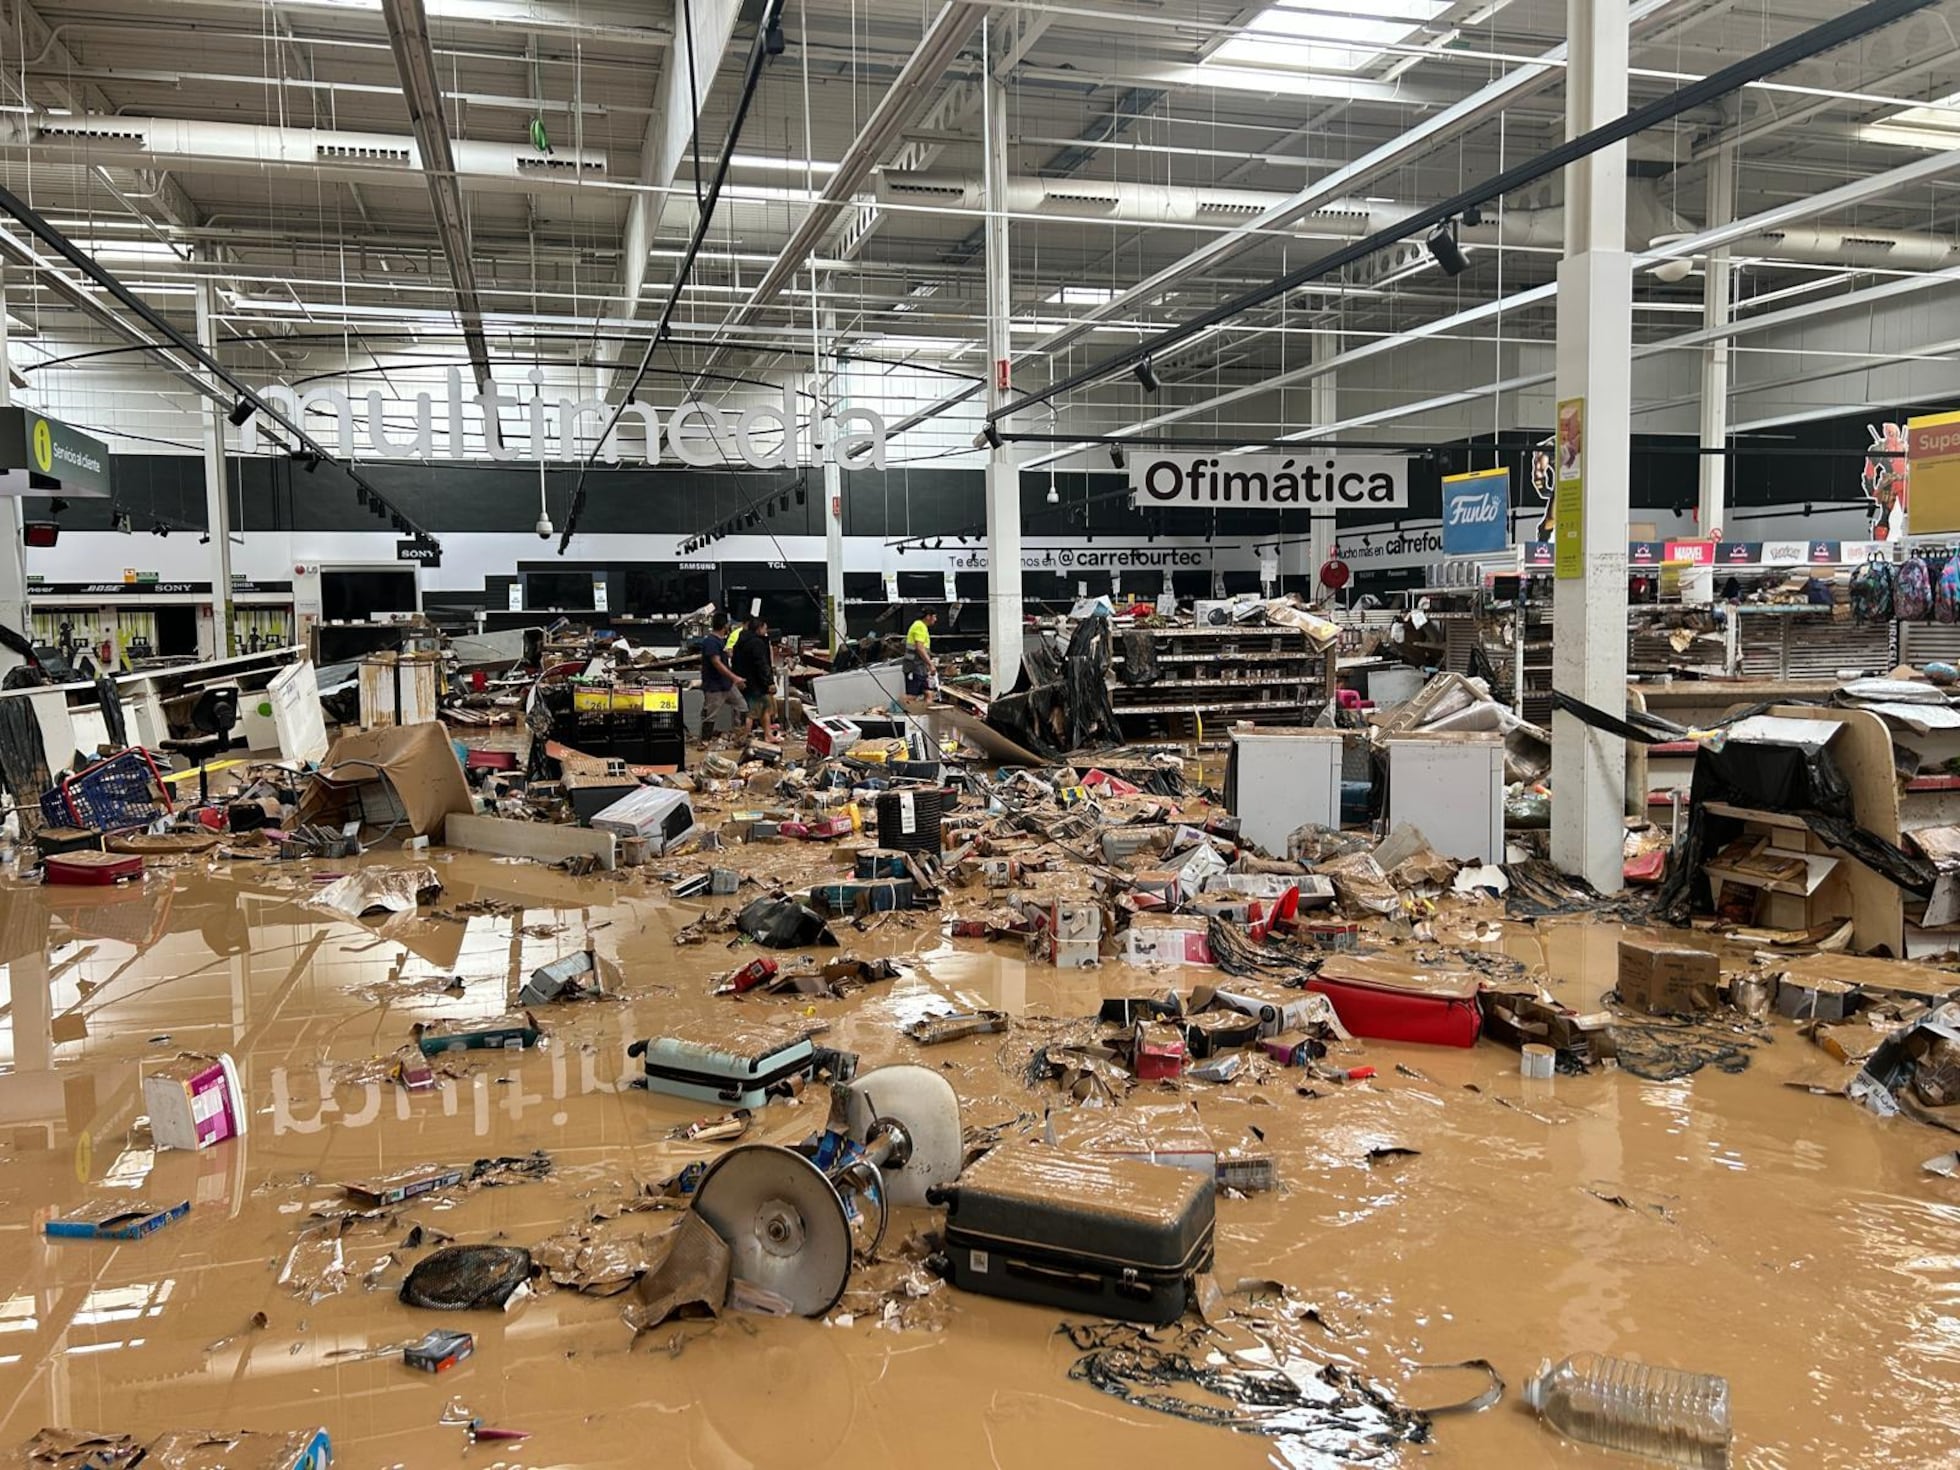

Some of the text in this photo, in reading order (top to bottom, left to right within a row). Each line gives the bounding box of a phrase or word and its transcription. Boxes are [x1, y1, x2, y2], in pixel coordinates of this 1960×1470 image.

[240, 365, 886, 472] multimedia
[53, 442, 77, 464] Servicio
[1145, 459, 1395, 502] Ofimática
[1449, 492, 1498, 525] Funko
[401, 549, 434, 558] SONY
[1375, 546, 1384, 556] en
[1674, 546, 1703, 561] MARVEL
[679, 562, 716, 571] SAMSUNG
[767, 561, 786, 569] TCL
[949, 556, 964, 567] Te
[82, 584, 125, 593] BOSE
[154, 584, 192, 592] SONY
